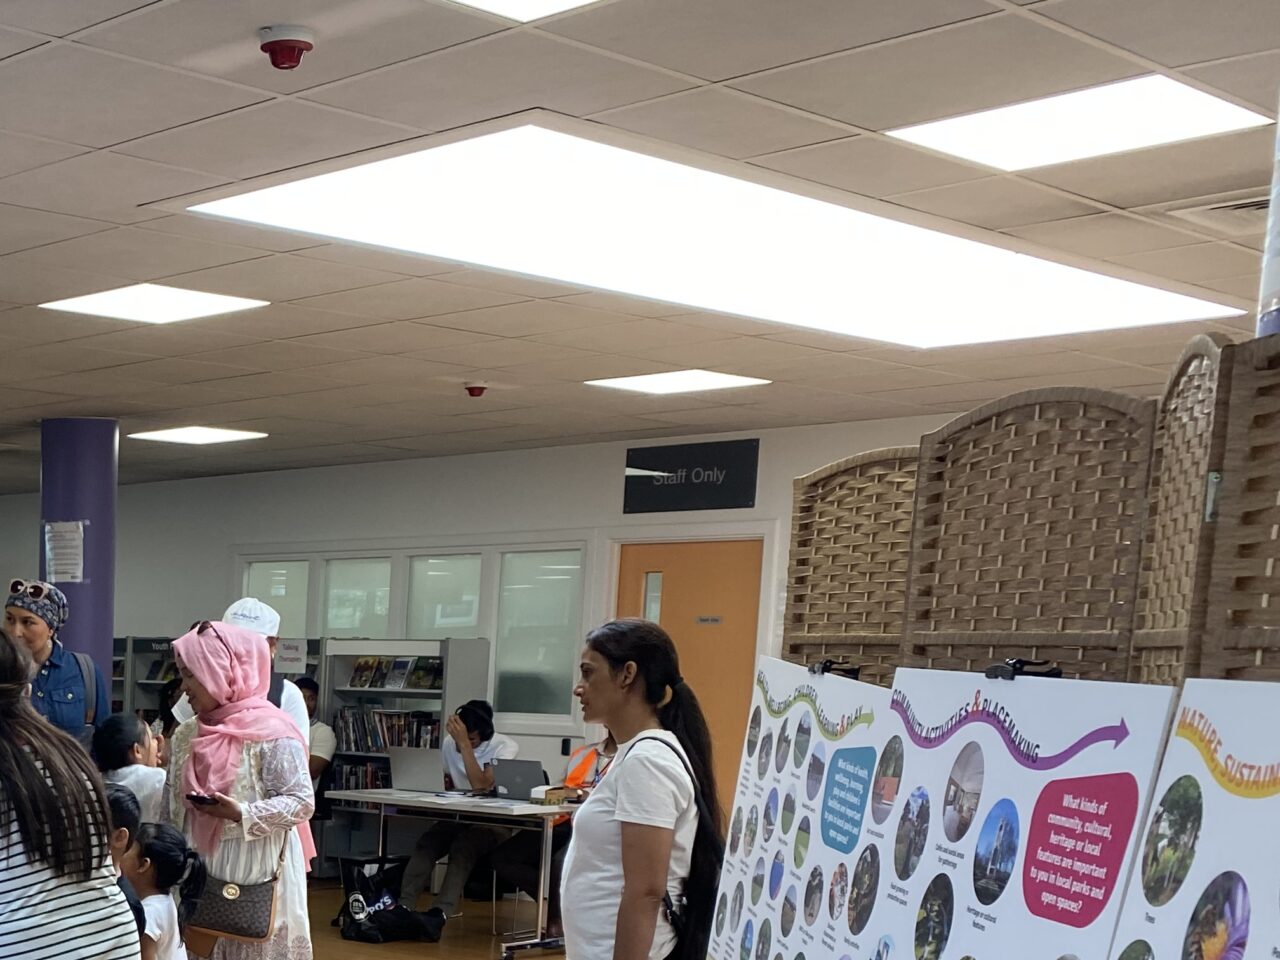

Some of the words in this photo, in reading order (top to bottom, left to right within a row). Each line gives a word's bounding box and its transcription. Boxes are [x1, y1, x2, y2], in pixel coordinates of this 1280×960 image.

[653, 469, 687, 486] Staff
[692, 467, 726, 485] Only
[892, 688, 924, 738] COMMUNITY
[924, 702, 970, 744] ACTIVITIES
[972, 689, 982, 716] &
[981, 698, 1041, 764] PLACEMAKING
[1063, 794, 1080, 809] What
[1080, 796, 1098, 813] kinds
[1098, 801, 1109, 815] of
[1048, 813, 1083, 834] community,
[1084, 820, 1112, 841] cultural,
[1049, 830, 1076, 852] heritage
[1076, 840, 1084, 851] or
[1084, 838, 1102, 856] local
[1036, 846, 1062, 865] features
[1062, 857, 1072, 869] are
[1072, 857, 1107, 879] important
[1030, 866, 1037, 878] to
[1036, 869, 1049, 883] you
[1048, 870, 1056, 884] in
[1055, 872, 1073, 889] local
[1071, 879, 1091, 896] parks
[1090, 886, 1106, 900] and
[1041, 891, 1057, 905] open
[1056, 895, 1083, 914] spaces?
